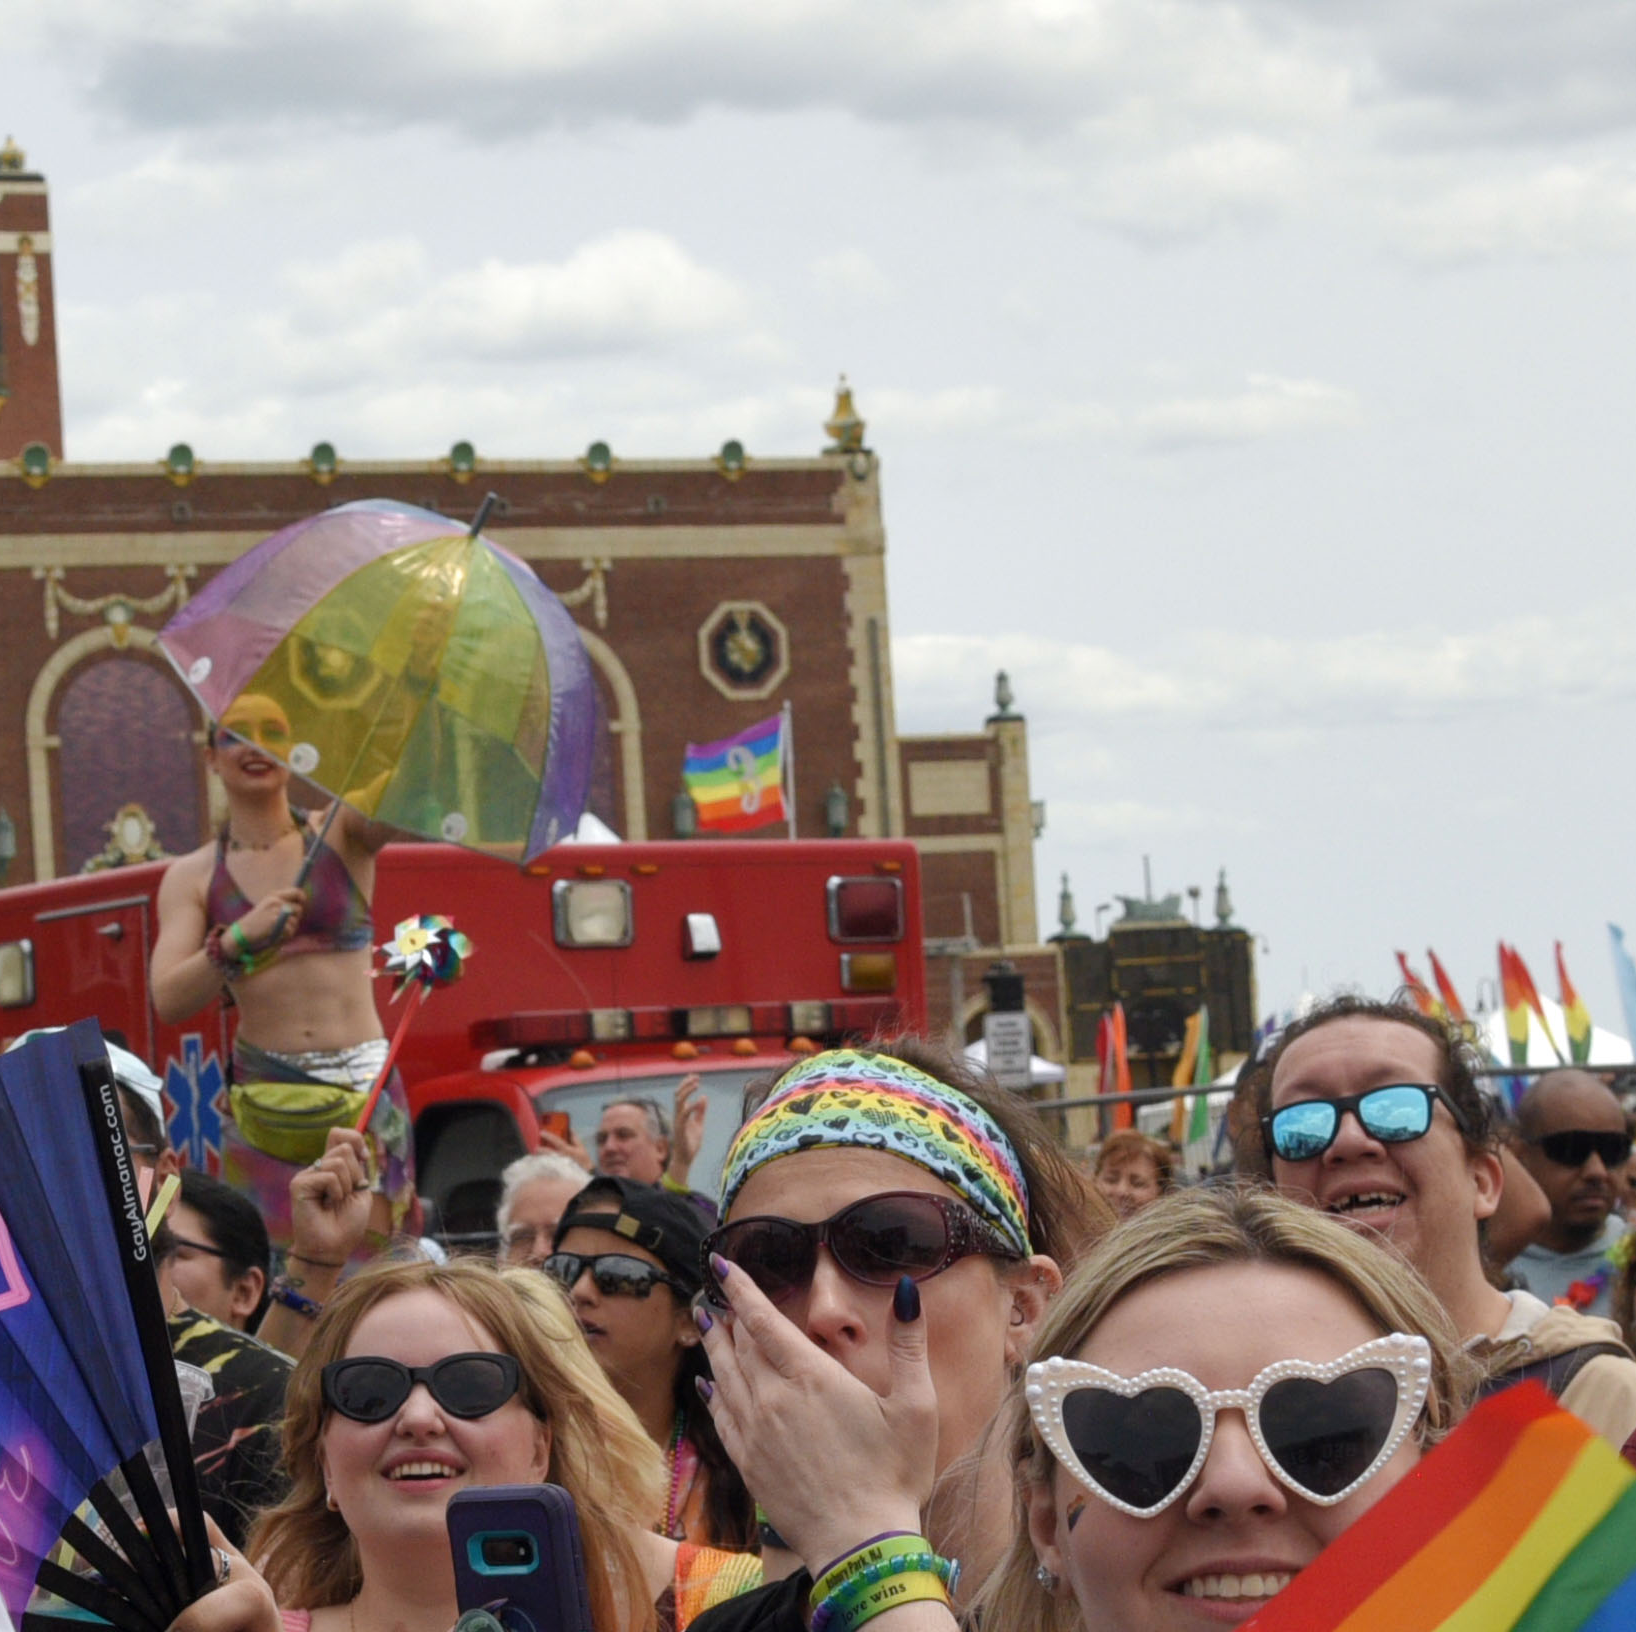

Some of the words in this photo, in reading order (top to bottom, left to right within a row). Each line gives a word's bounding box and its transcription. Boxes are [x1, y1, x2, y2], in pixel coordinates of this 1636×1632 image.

[99, 1083, 148, 1262] GayAlmanac.com
[841, 1600, 868, 1626] love
[869, 1581, 907, 1604] wins
